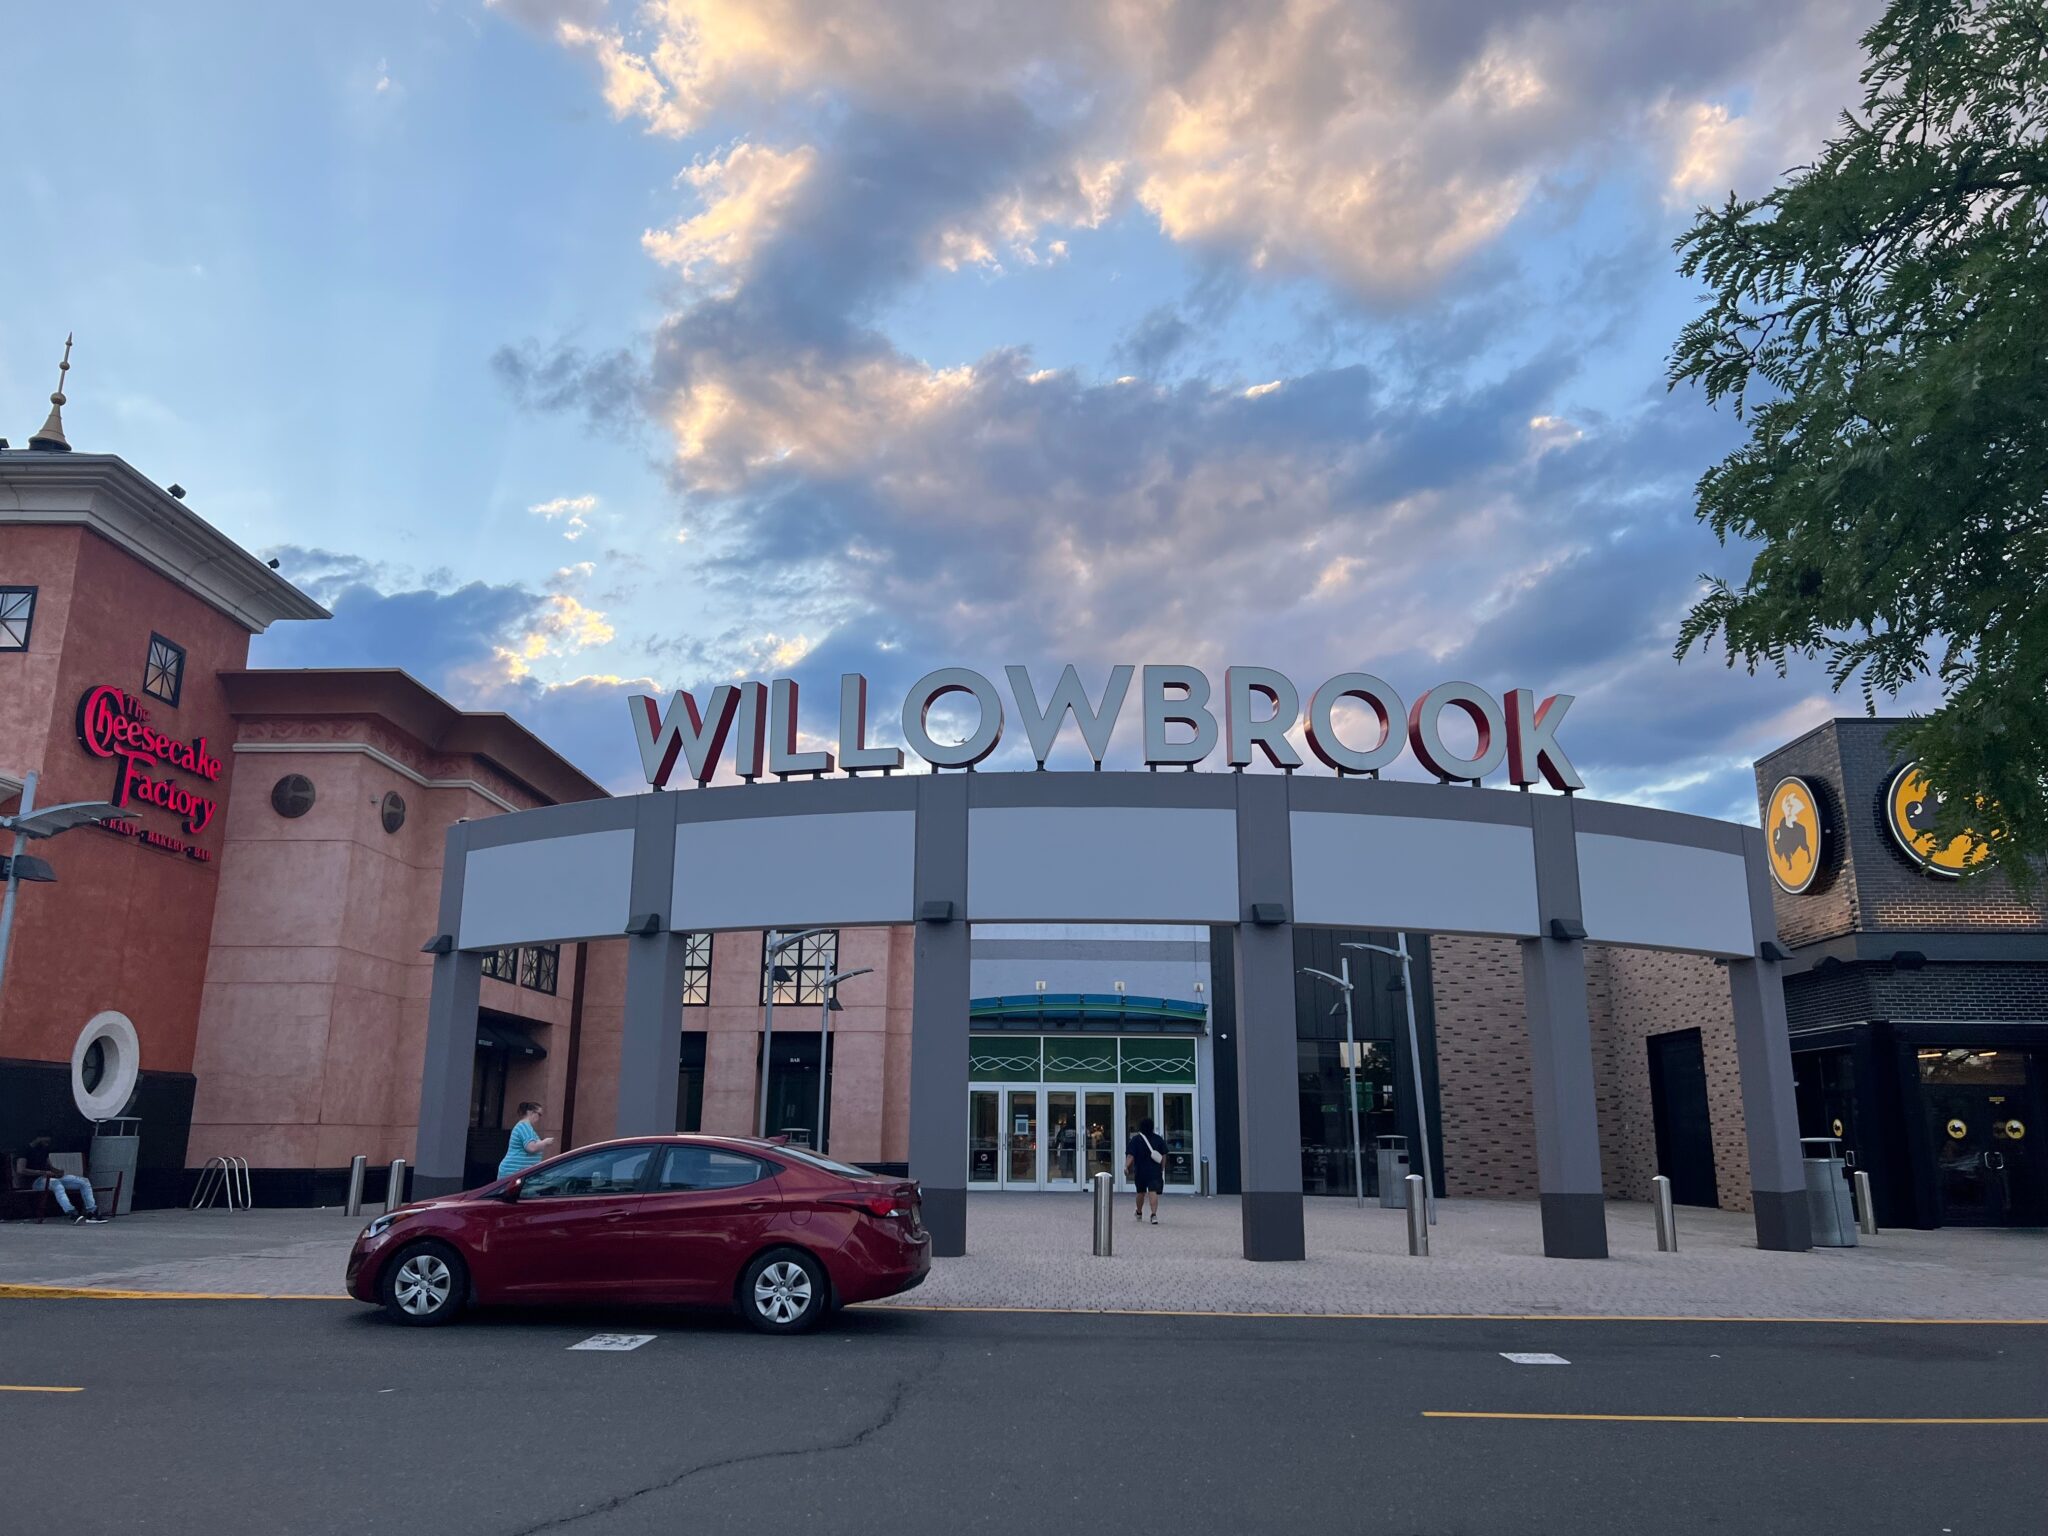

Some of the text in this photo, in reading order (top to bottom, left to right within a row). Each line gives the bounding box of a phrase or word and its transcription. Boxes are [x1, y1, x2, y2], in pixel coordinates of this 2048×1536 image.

[82, 684, 223, 782] Cheesecake
[125, 694, 151, 721] The
[628, 664, 1586, 790] WILLOWBROOK
[113, 741, 217, 832] Factory
[147, 831, 186, 852] BAKERY
[194, 847, 212, 861] BAR
